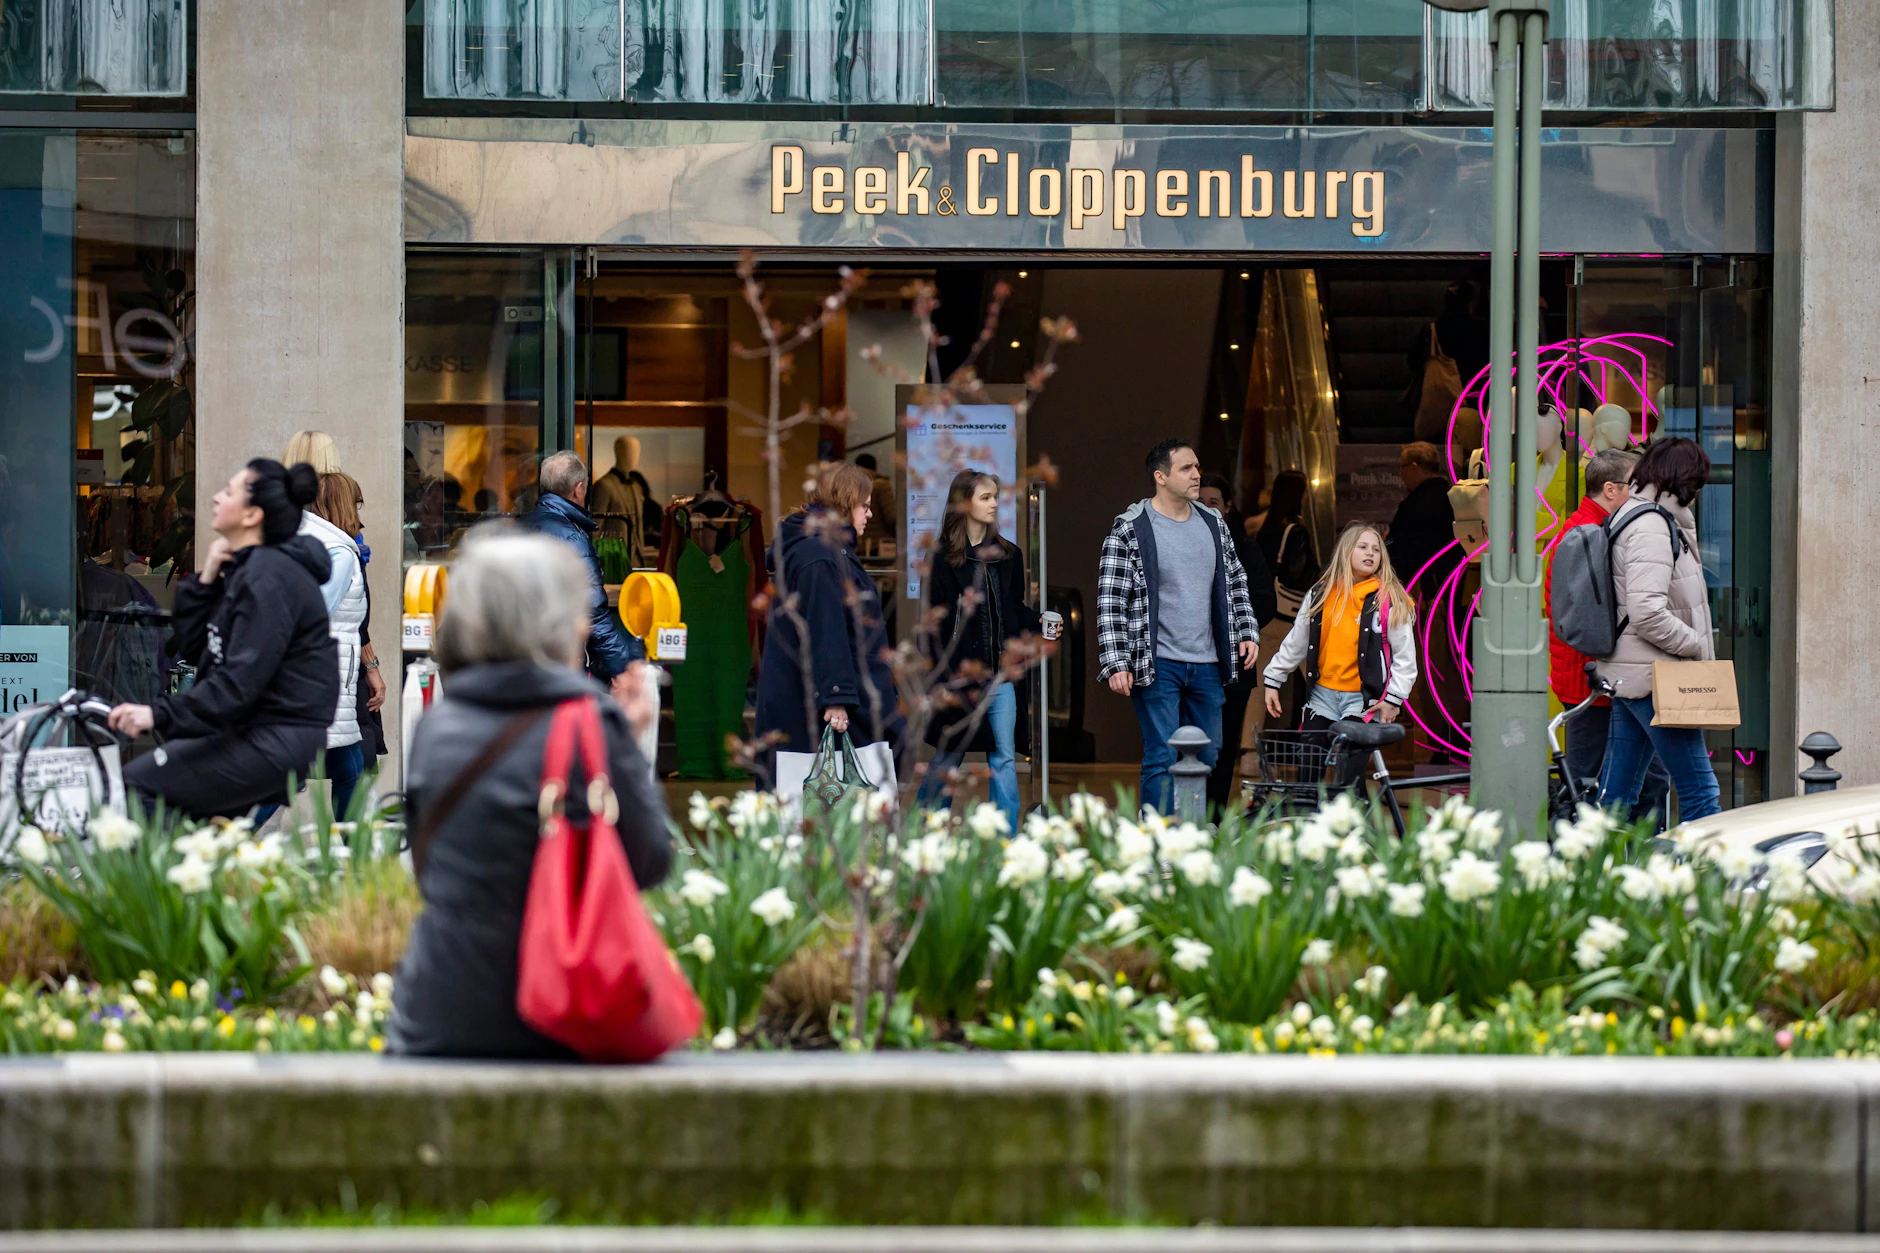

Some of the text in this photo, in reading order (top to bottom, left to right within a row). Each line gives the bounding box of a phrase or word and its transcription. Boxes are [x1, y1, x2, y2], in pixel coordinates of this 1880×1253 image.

[771, 145, 1386, 238] Peek & Cloppenburg
[931, 422, 1007, 430] Geschenkservice
[404, 625, 421, 636] BG
[659, 634, 680, 646] ABG
[13, 654, 36, 662] VON
[1, 677, 24, 685] EXT
[1677, 686, 1717, 694] NESPRESSO
